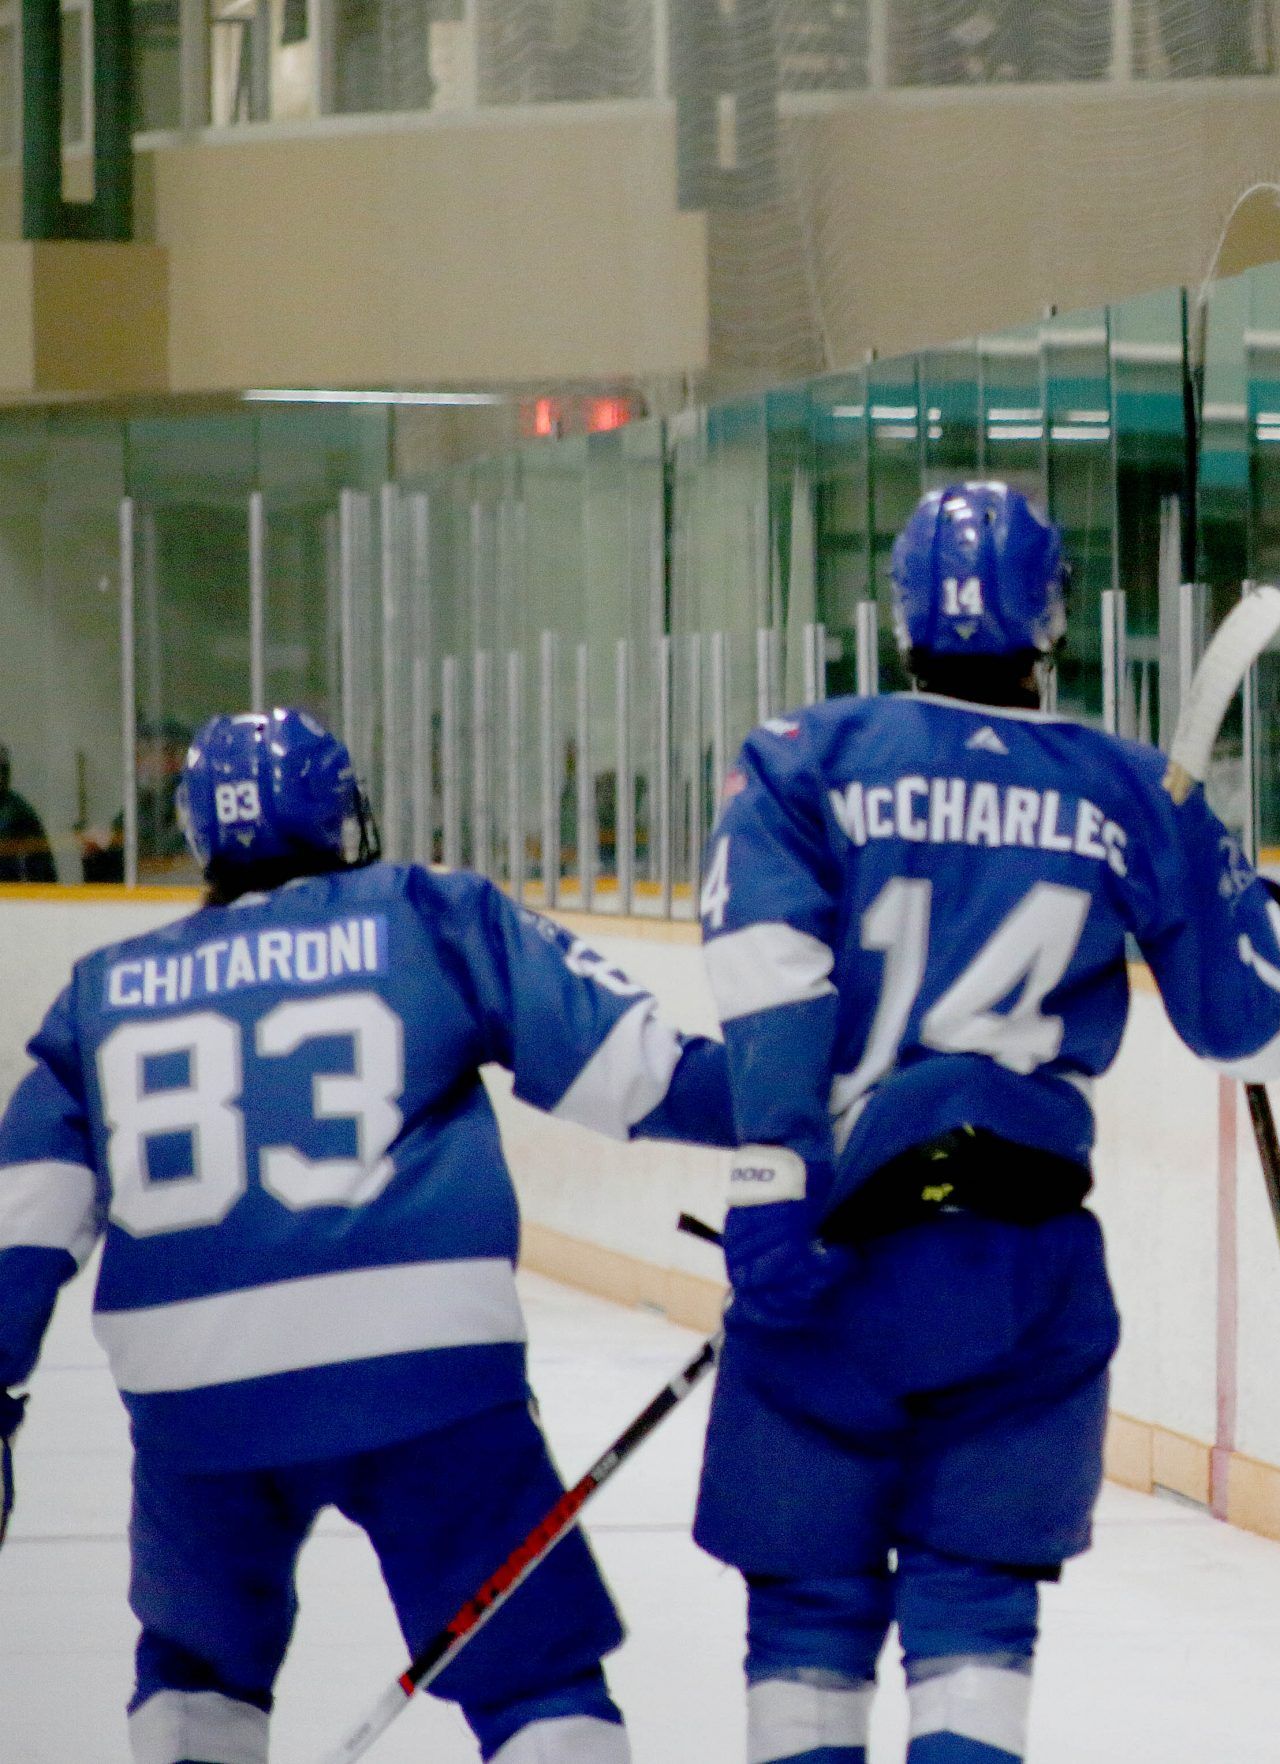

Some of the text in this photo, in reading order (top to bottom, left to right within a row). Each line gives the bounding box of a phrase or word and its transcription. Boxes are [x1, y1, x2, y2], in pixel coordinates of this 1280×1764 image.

[942, 576, 983, 616] 14
[215, 781, 262, 825] 83
[108, 918, 378, 1006] CHITARONI
[828, 876, 1092, 1135] 14
[95, 990, 405, 1240] 83
